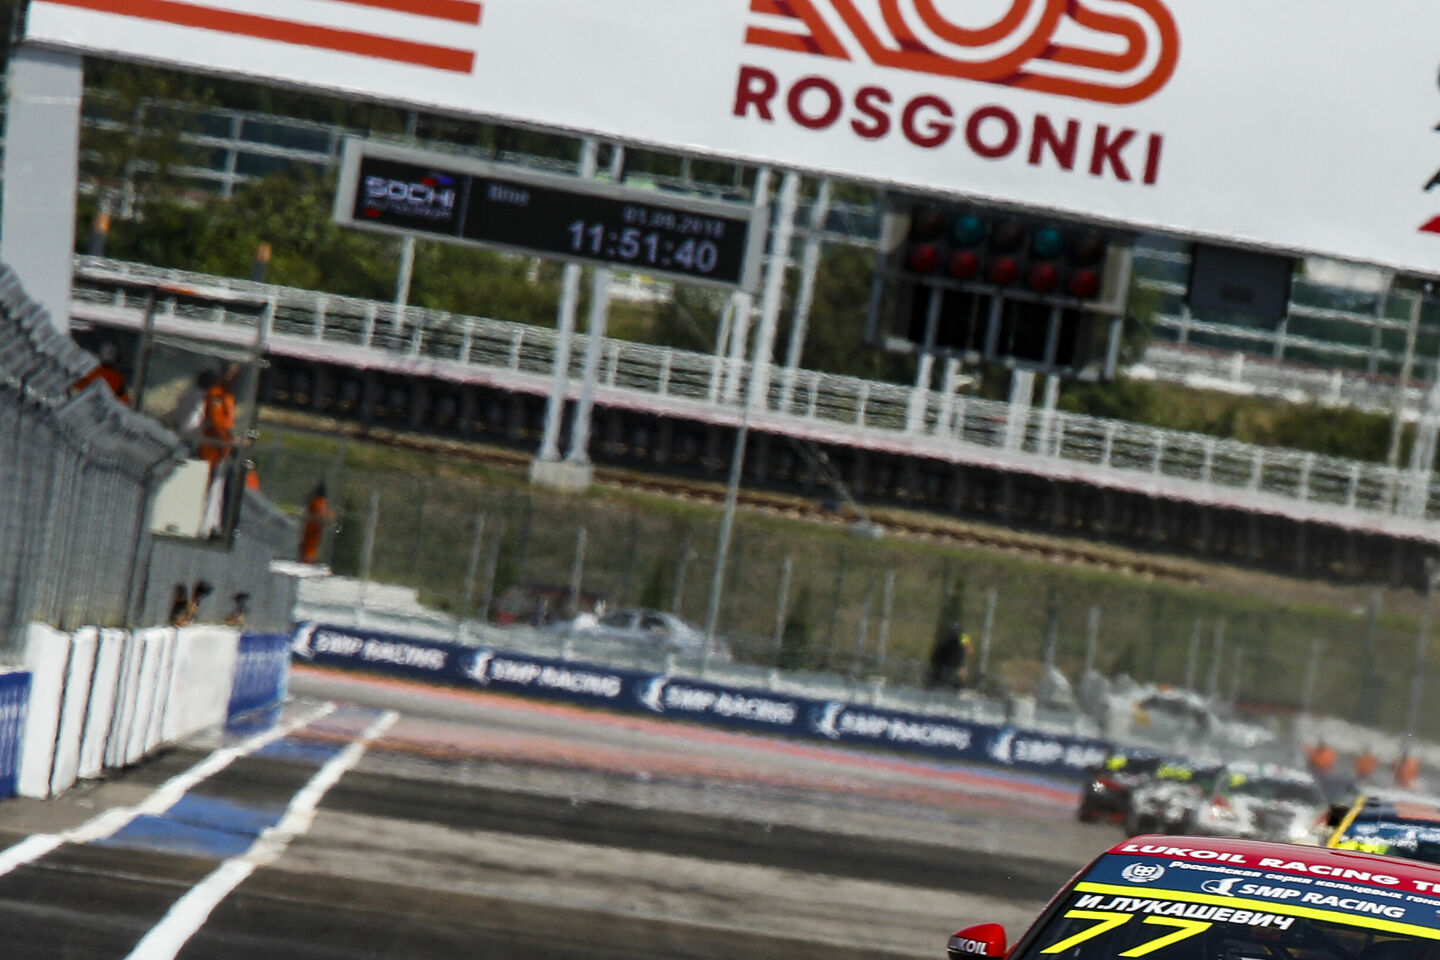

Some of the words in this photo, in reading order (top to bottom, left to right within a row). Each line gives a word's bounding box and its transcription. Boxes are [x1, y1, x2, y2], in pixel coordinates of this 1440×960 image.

[733, 64, 1164, 186] ROSGONKI
[568, 219, 718, 273] 11:51:40
[1121, 844, 1247, 864] LUKOIL
[1258, 857, 1400, 886] RACING
[1169, 861, 1261, 878] Российская
[1074, 895, 1296, 931] И.ЛУКАШЕВИЧ
[1238, 884, 1301, 900] SMP
[1301, 892, 1406, 918] RACING
[1040, 910, 1213, 958] 77
